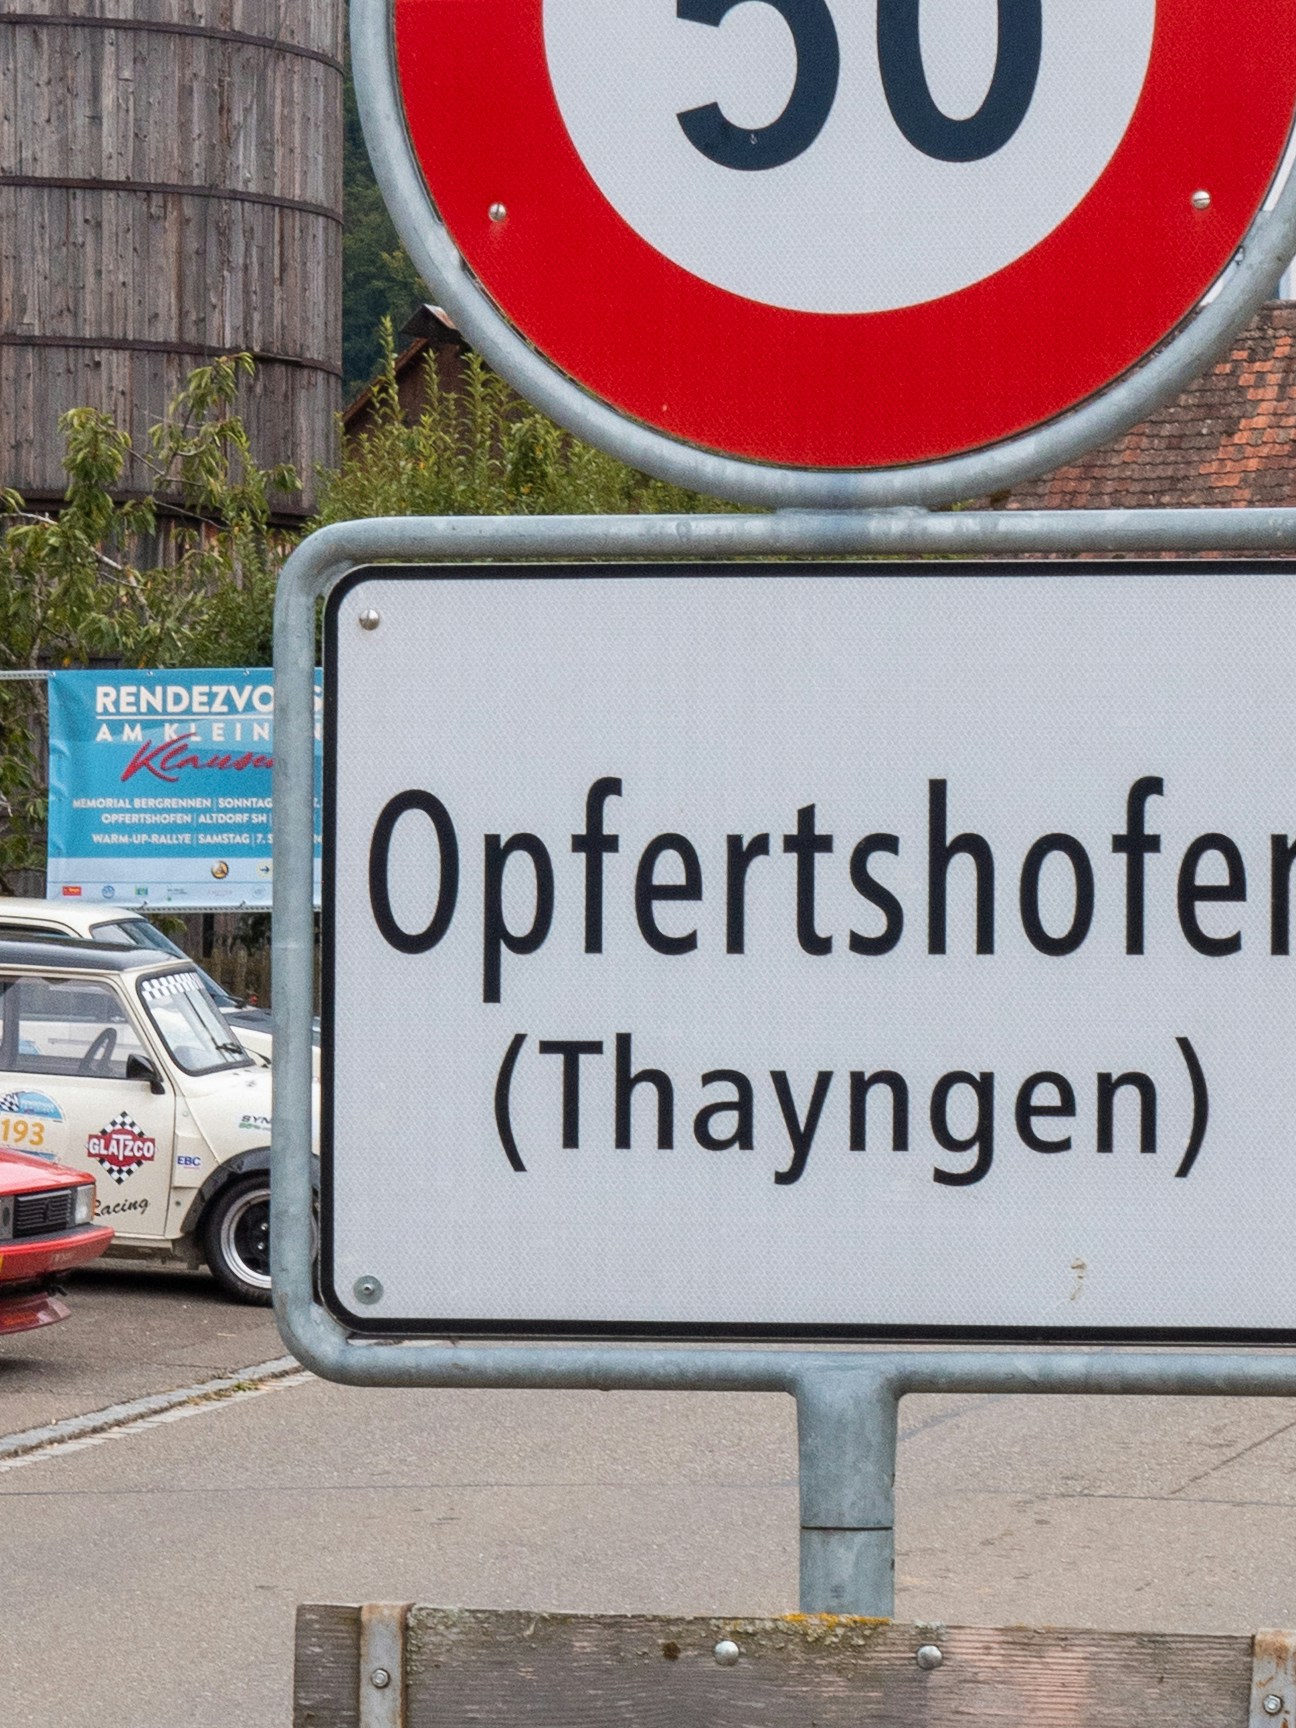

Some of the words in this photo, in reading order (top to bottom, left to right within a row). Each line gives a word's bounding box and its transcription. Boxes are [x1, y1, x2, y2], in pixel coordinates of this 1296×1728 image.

[95, 723, 143, 742] AM
[72, 797, 132, 809] MEMORIAL
[133, 797, 212, 809] BERGRENNEN
[101, 812, 192, 825] OPFERTSHOFEN
[198, 812, 249, 824] ALTDORF
[251, 813, 267, 824] SH
[91, 833, 191, 845] WARM-UP-RALLYE
[197, 833, 250, 845] SAMSTAG
[494, 1032, 1209, 1187] (Thayngen)
[1, 1118, 45, 1147] 193
[88, 1132, 154, 1162] GLATZCO
[177, 1155, 201, 1167] EBC
